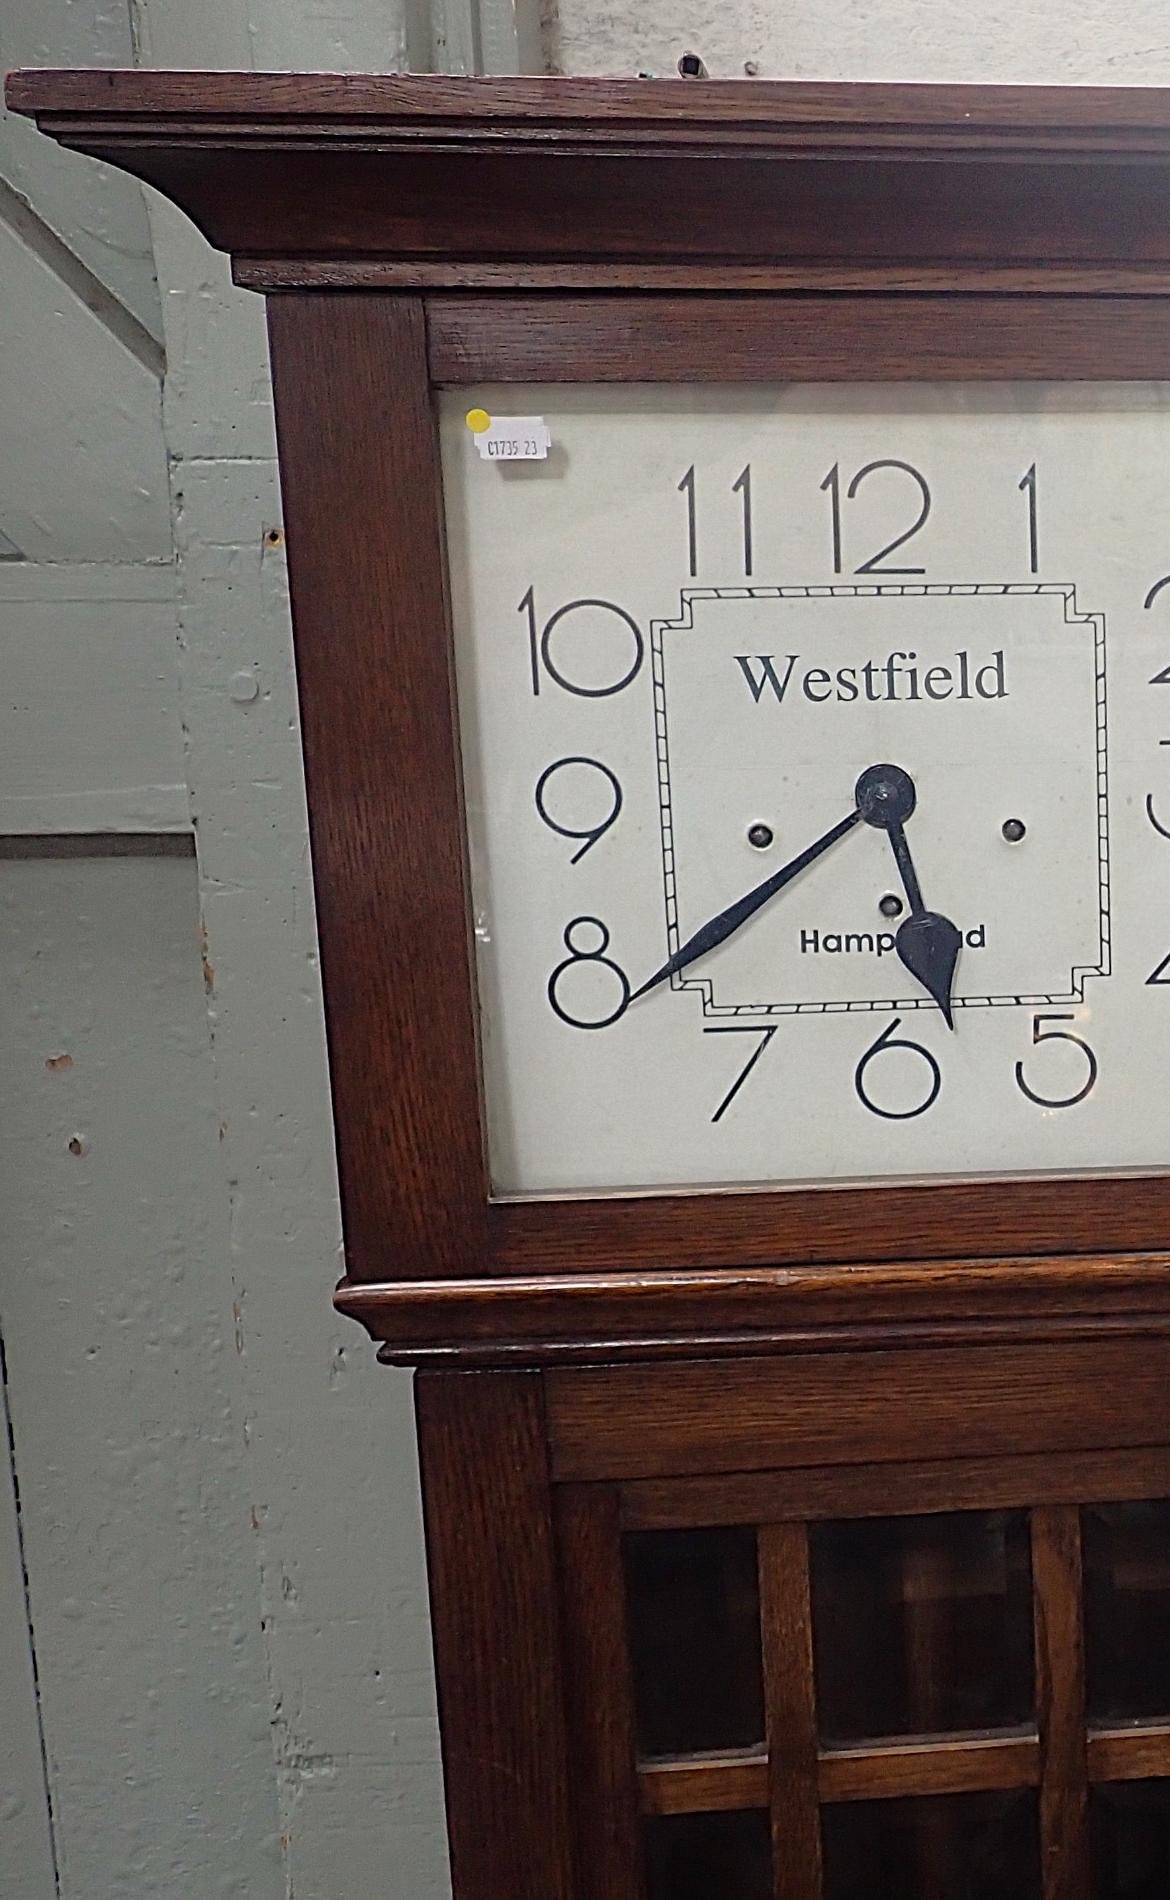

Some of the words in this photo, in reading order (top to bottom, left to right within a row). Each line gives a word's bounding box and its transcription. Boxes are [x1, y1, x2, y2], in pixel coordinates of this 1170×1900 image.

[488, 441, 518, 456] C1735
[525, 441, 537, 455] 23
[678, 463, 752, 576] 11
[820, 459, 932, 575] 12
[1019, 462, 1037, 573] 1
[518, 586, 644, 698] 10
[733, 650, 1009, 704] Westfield
[535, 756, 623, 865] 9
[548, 916, 632, 1030] 8
[800, 924, 986, 957] Hampd
[703, 1025, 778, 1122] 7
[855, 1017, 941, 1120] 6
[1015, 1014, 1098, 1108] 5
